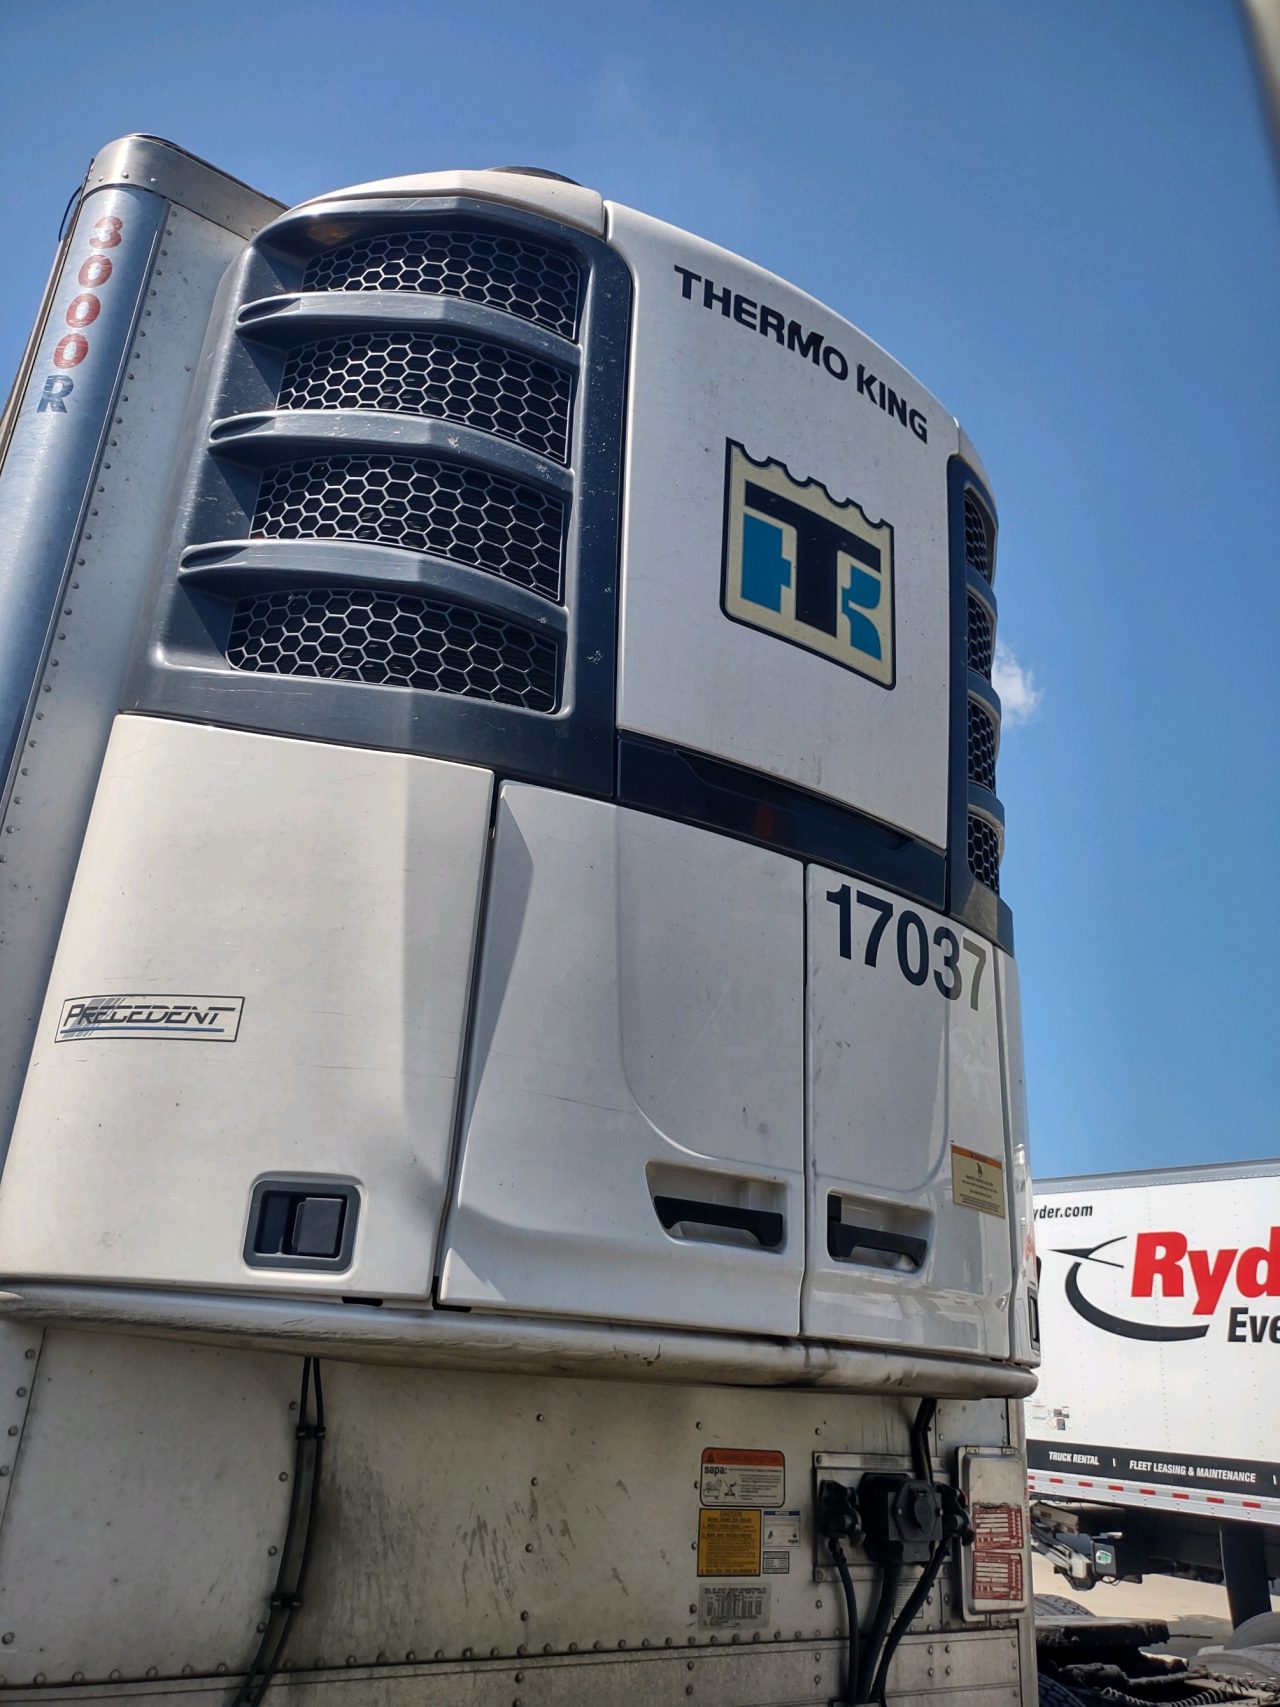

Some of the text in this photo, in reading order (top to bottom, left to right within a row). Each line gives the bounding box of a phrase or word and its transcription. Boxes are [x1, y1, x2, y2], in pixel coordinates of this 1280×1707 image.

[36, 215, 123, 414] 3000R
[674, 264, 928, 444] THERMO KING
[826, 883, 987, 1012] 17037
[63, 1003, 236, 1026] PRECEDENT
[1131, 1226, 1280, 1315] Ryd
[1227, 1307, 1280, 1344] Eve
[1049, 1451, 1100, 1465] TRUCK RENTAL
[1129, 1460, 1257, 1483] FLEET LEASING & MAINTENANCE
